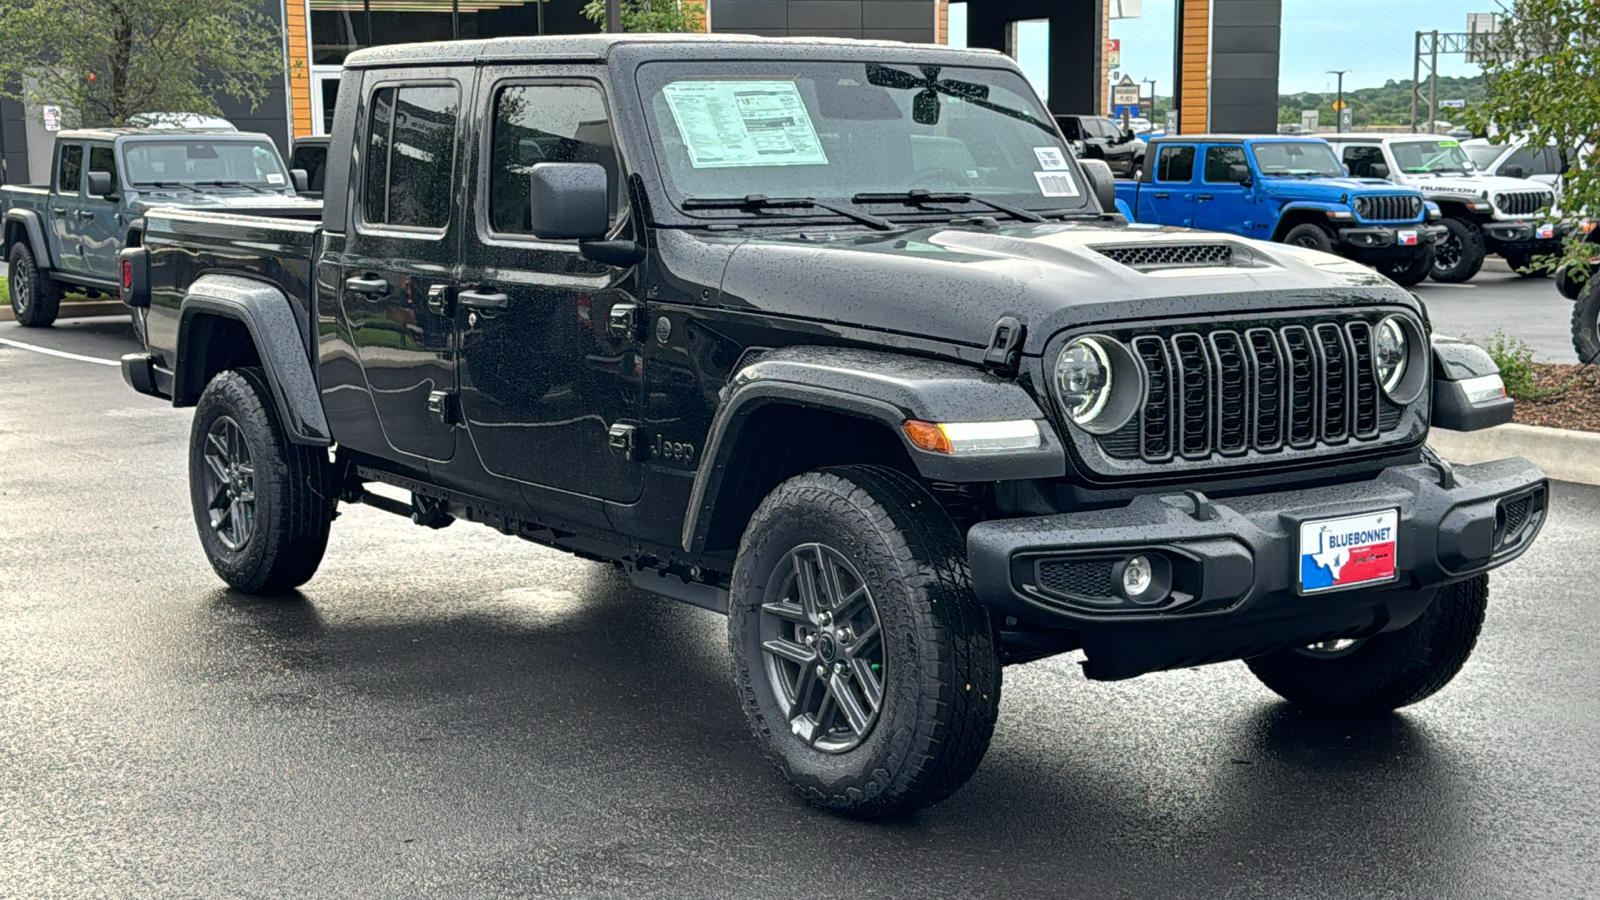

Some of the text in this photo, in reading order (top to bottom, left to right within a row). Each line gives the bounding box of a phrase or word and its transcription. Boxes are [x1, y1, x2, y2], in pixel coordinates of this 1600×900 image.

[1420, 185, 1477, 194] RUBICON
[649, 433, 694, 466] Jeep
[1329, 527, 1391, 549] BLUEBONNET
